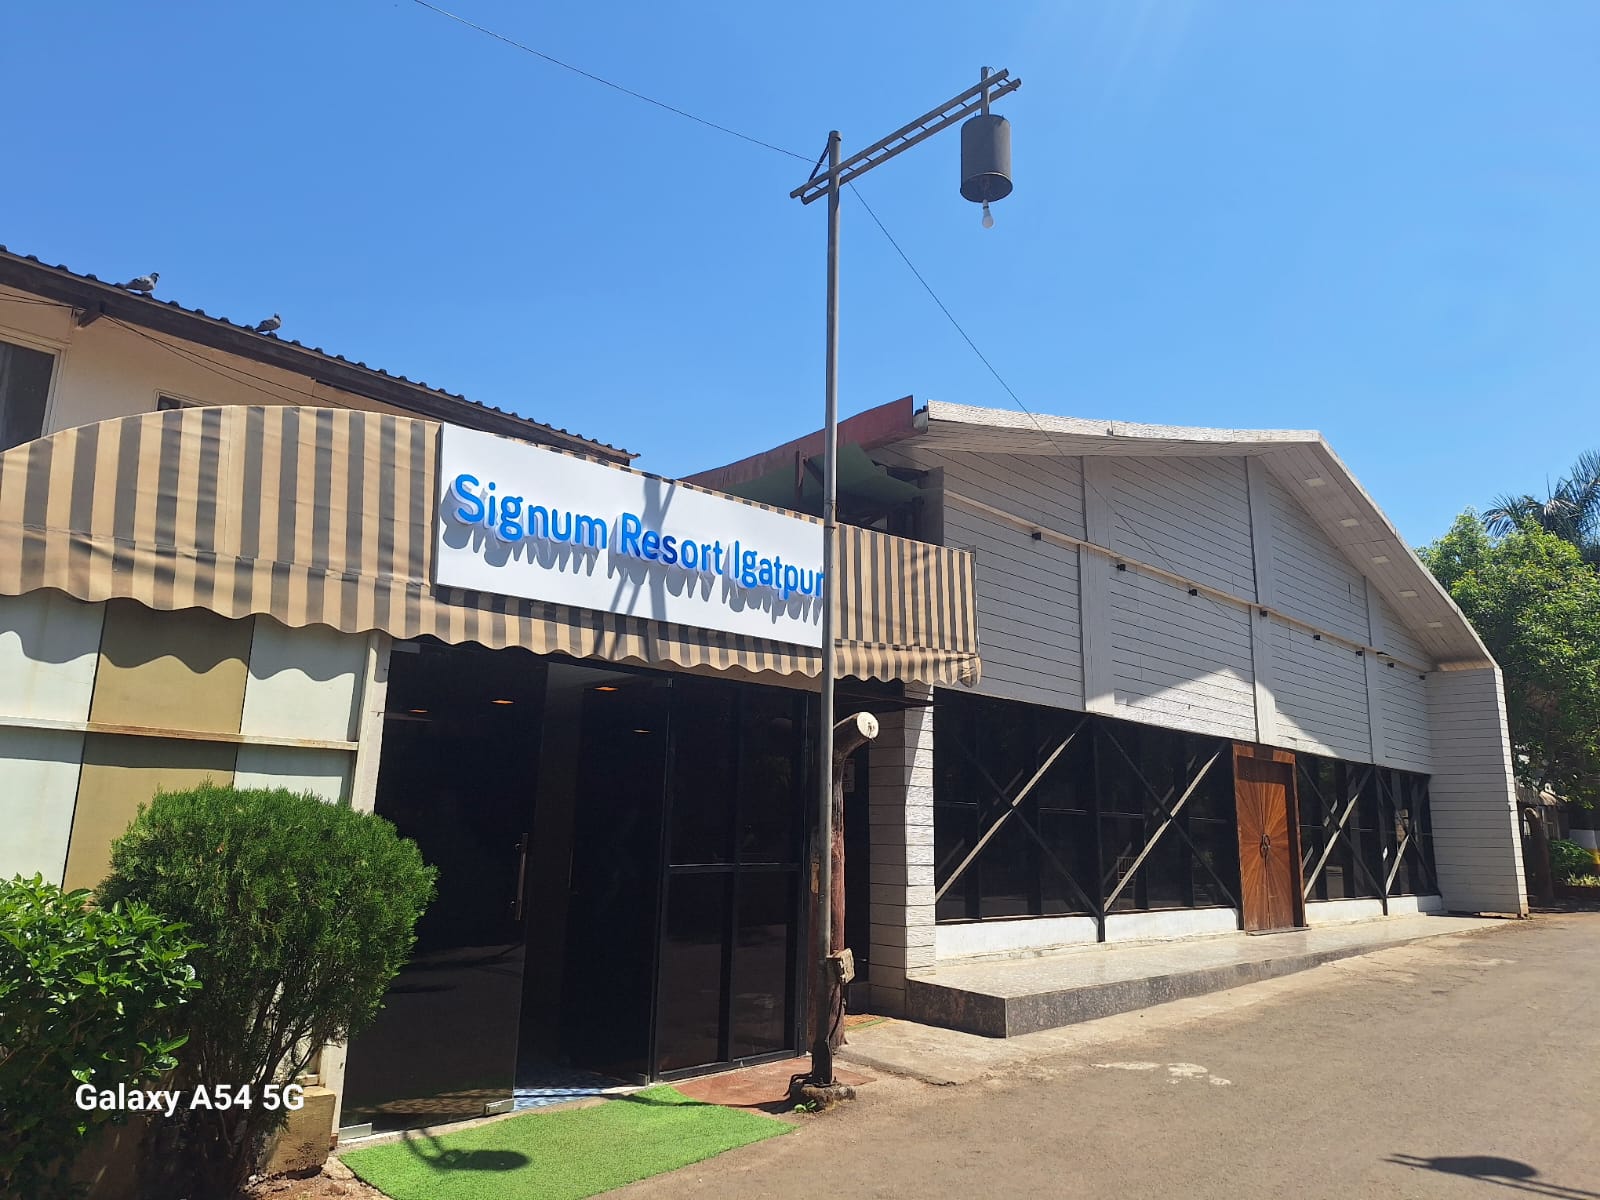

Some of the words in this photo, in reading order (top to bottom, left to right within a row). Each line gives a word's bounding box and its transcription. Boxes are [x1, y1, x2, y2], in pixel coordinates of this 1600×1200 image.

[453, 473, 608, 549] Signum
[620, 512, 723, 576] Resort
[733, 540, 825, 601] Igatpur
